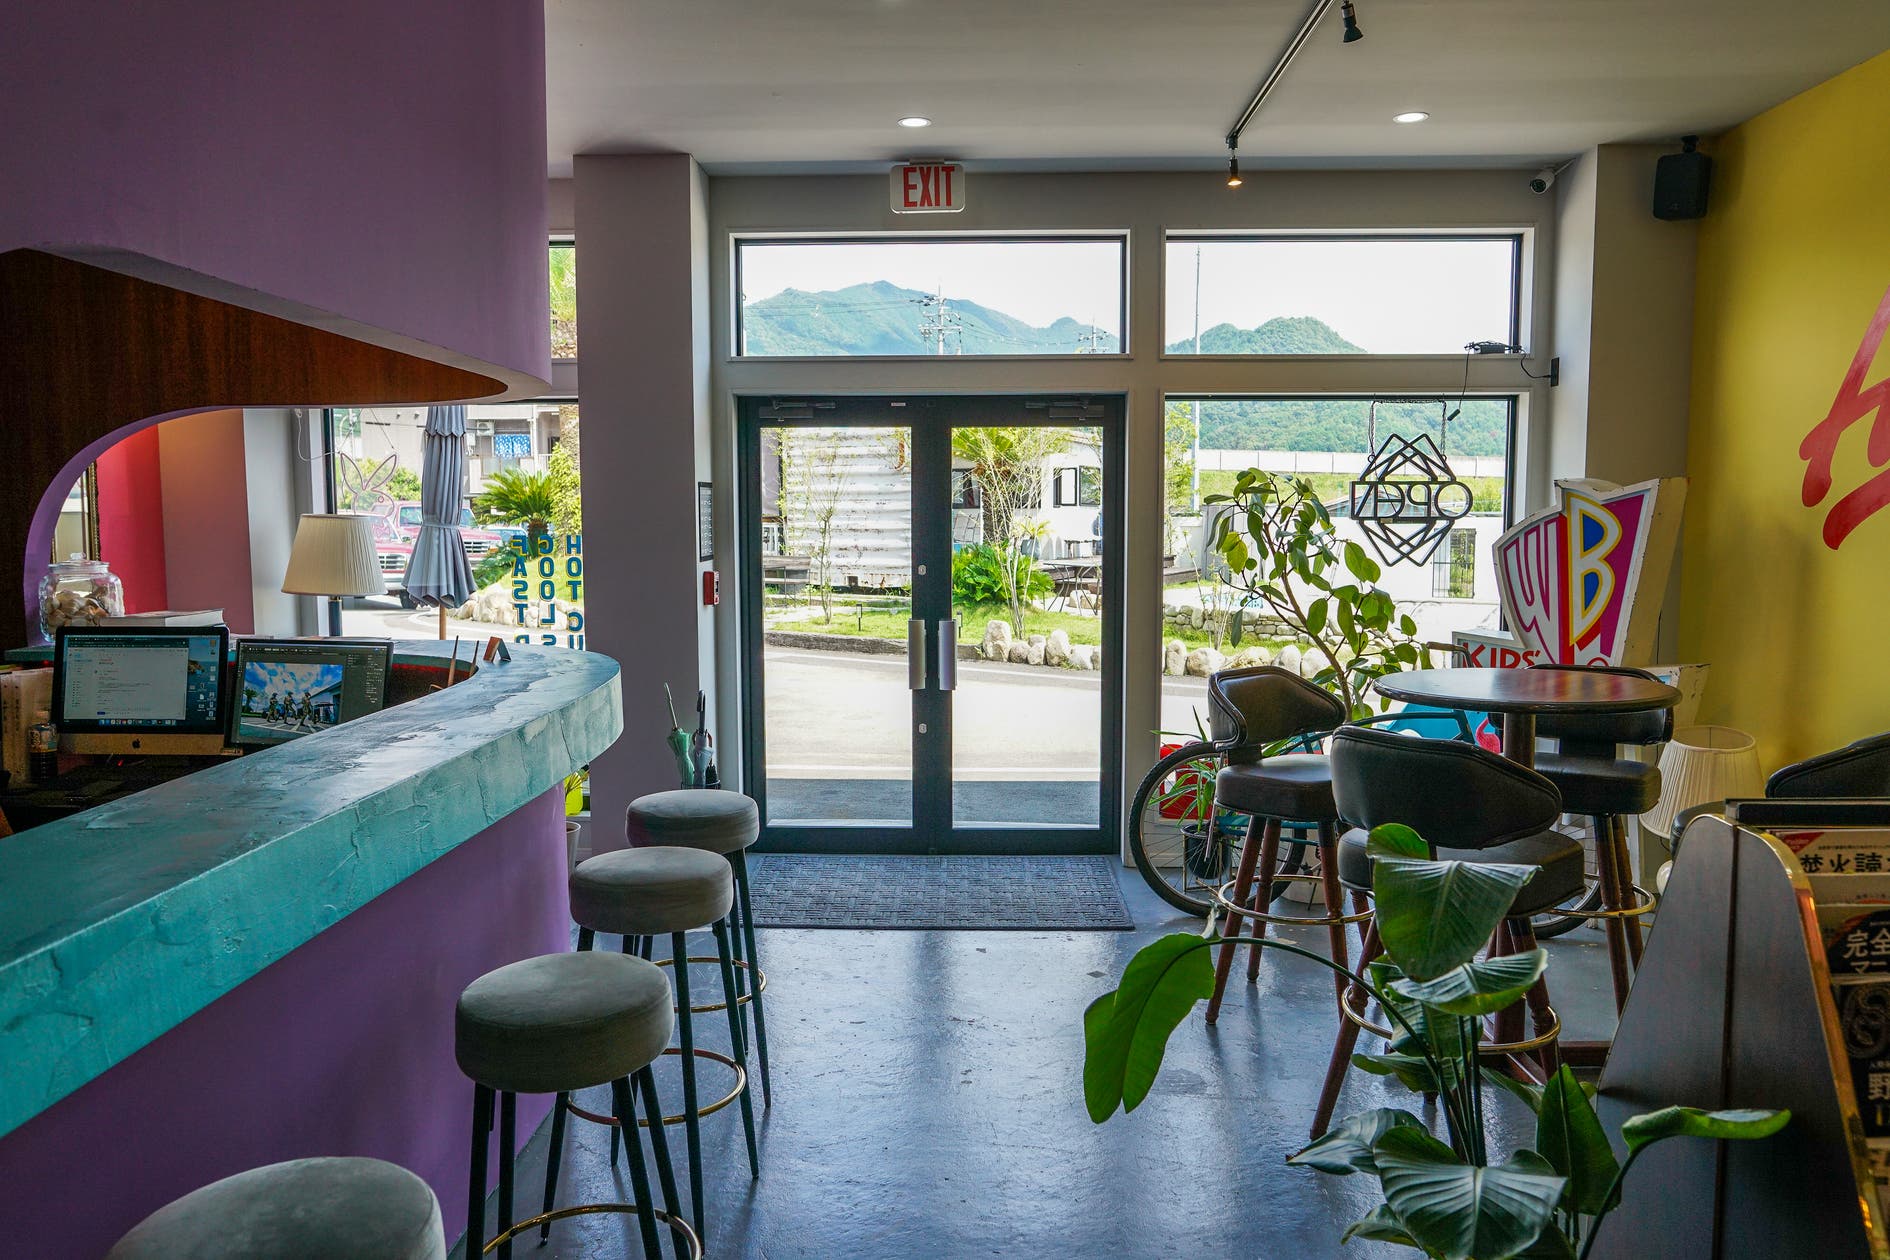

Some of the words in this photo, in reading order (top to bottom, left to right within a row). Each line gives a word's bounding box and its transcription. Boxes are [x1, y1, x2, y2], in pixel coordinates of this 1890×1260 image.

[903, 165, 955, 207] EXIT
[1800, 852, 1890, 873] 焚火読
